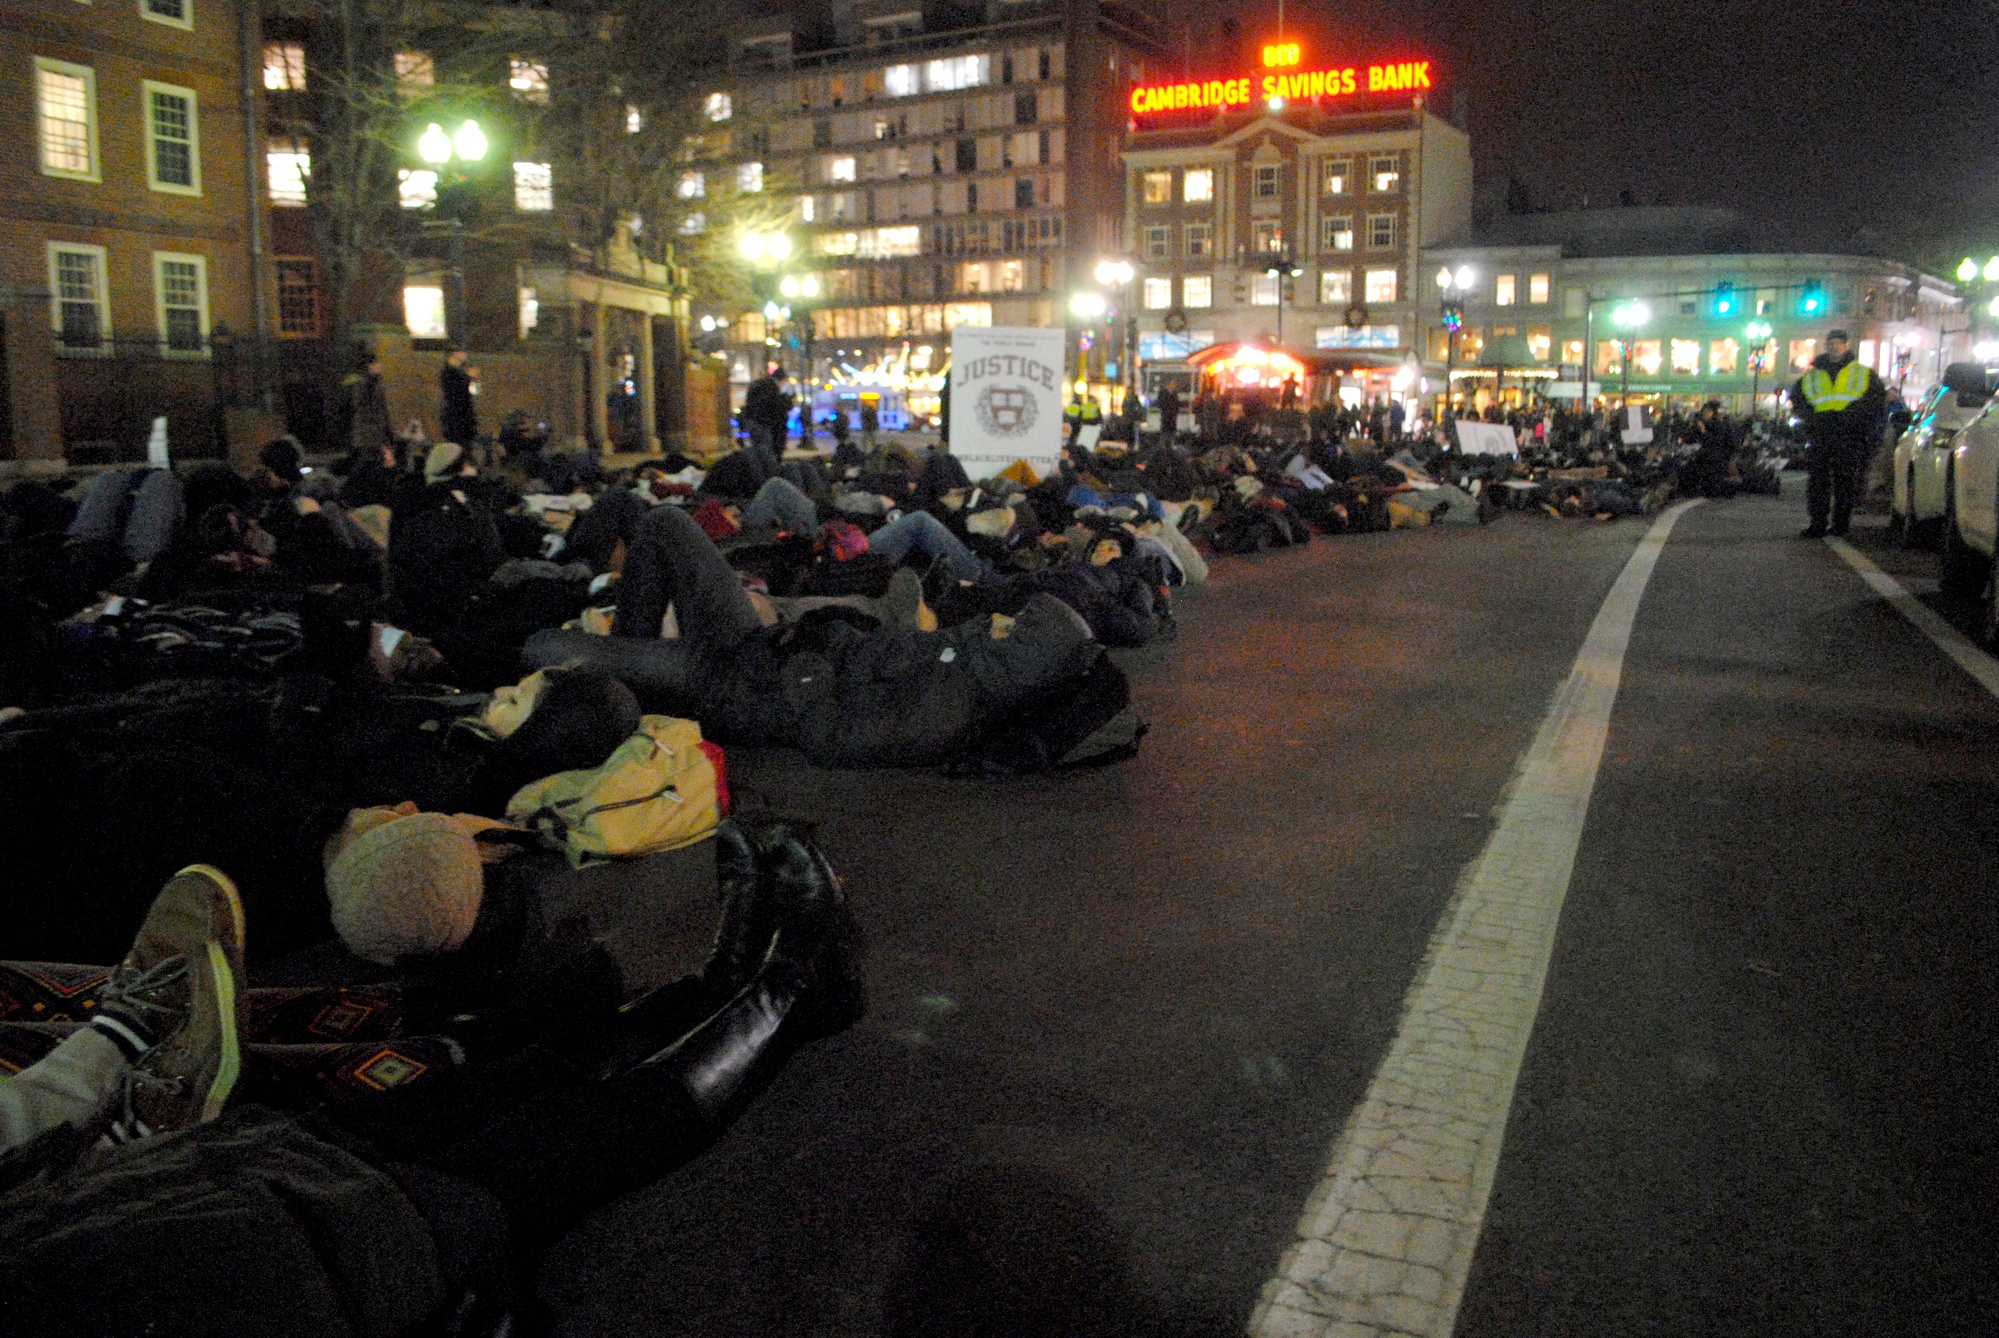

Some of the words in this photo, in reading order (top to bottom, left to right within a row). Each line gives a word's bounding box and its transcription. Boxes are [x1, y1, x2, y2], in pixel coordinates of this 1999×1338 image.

[1131, 78, 1250, 113] CAMBRIDGE
[1262, 68, 1356, 100] SAVINGS
[1369, 61, 1431, 92] BANK
[957, 354, 1055, 391] JUSTICE
